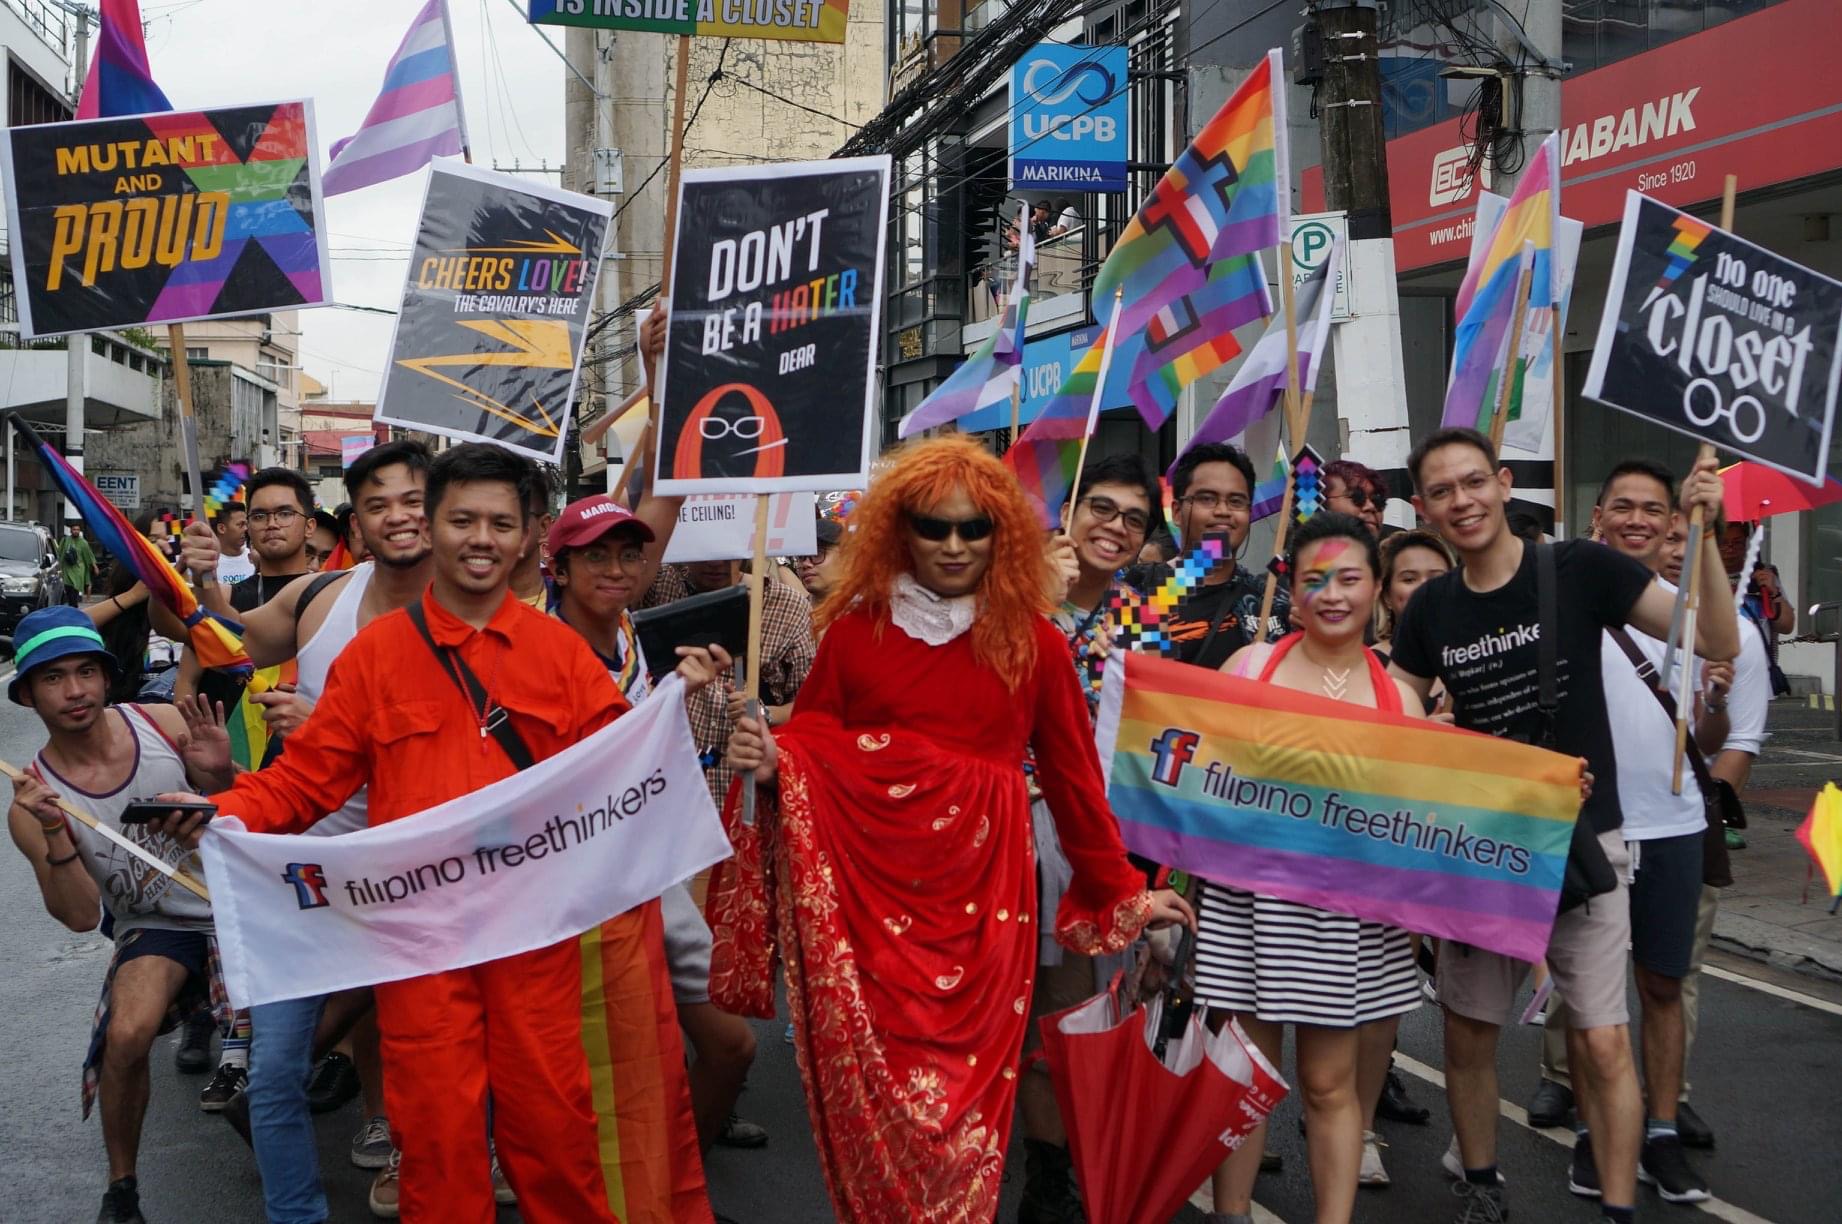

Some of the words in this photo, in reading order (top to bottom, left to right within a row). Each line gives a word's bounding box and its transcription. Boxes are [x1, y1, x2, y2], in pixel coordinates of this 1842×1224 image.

[722, 0, 824, 28] CLOSET
[1023, 114, 1116, 142] UCPB
[56, 134, 219, 175] MUTANT
[114, 174, 162, 194] AND
[1022, 165, 1103, 182] MARIKINA
[1638, 171, 1668, 192] Since
[1670, 160, 1696, 184] 1920
[46, 192, 230, 291] PROUD
[708, 208, 829, 302] DON'T
[418, 256, 514, 291] CHEERS
[518, 258, 588, 293] LOVE!
[1714, 251, 1747, 288] no
[1752, 270, 1797, 308] one
[454, 294, 477, 313] THE
[478, 295, 547, 314] CAVALRY'S
[548, 297, 579, 315] HERE
[702, 308, 737, 356] BE
[743, 301, 762, 345] A
[770, 268, 858, 335] HATER
[778, 343, 816, 375] DEAR
[1647, 272, 1814, 418] closet
[1030, 361, 1061, 398] UCPB
[97, 476, 136, 489] EENT
[691, 504, 735, 521] CEILING!
[1201, 760, 1313, 820] filipino
[1321, 792, 1532, 875] freethinkers
[344, 855, 466, 907] filipino
[471, 768, 667, 876] freethinkers
